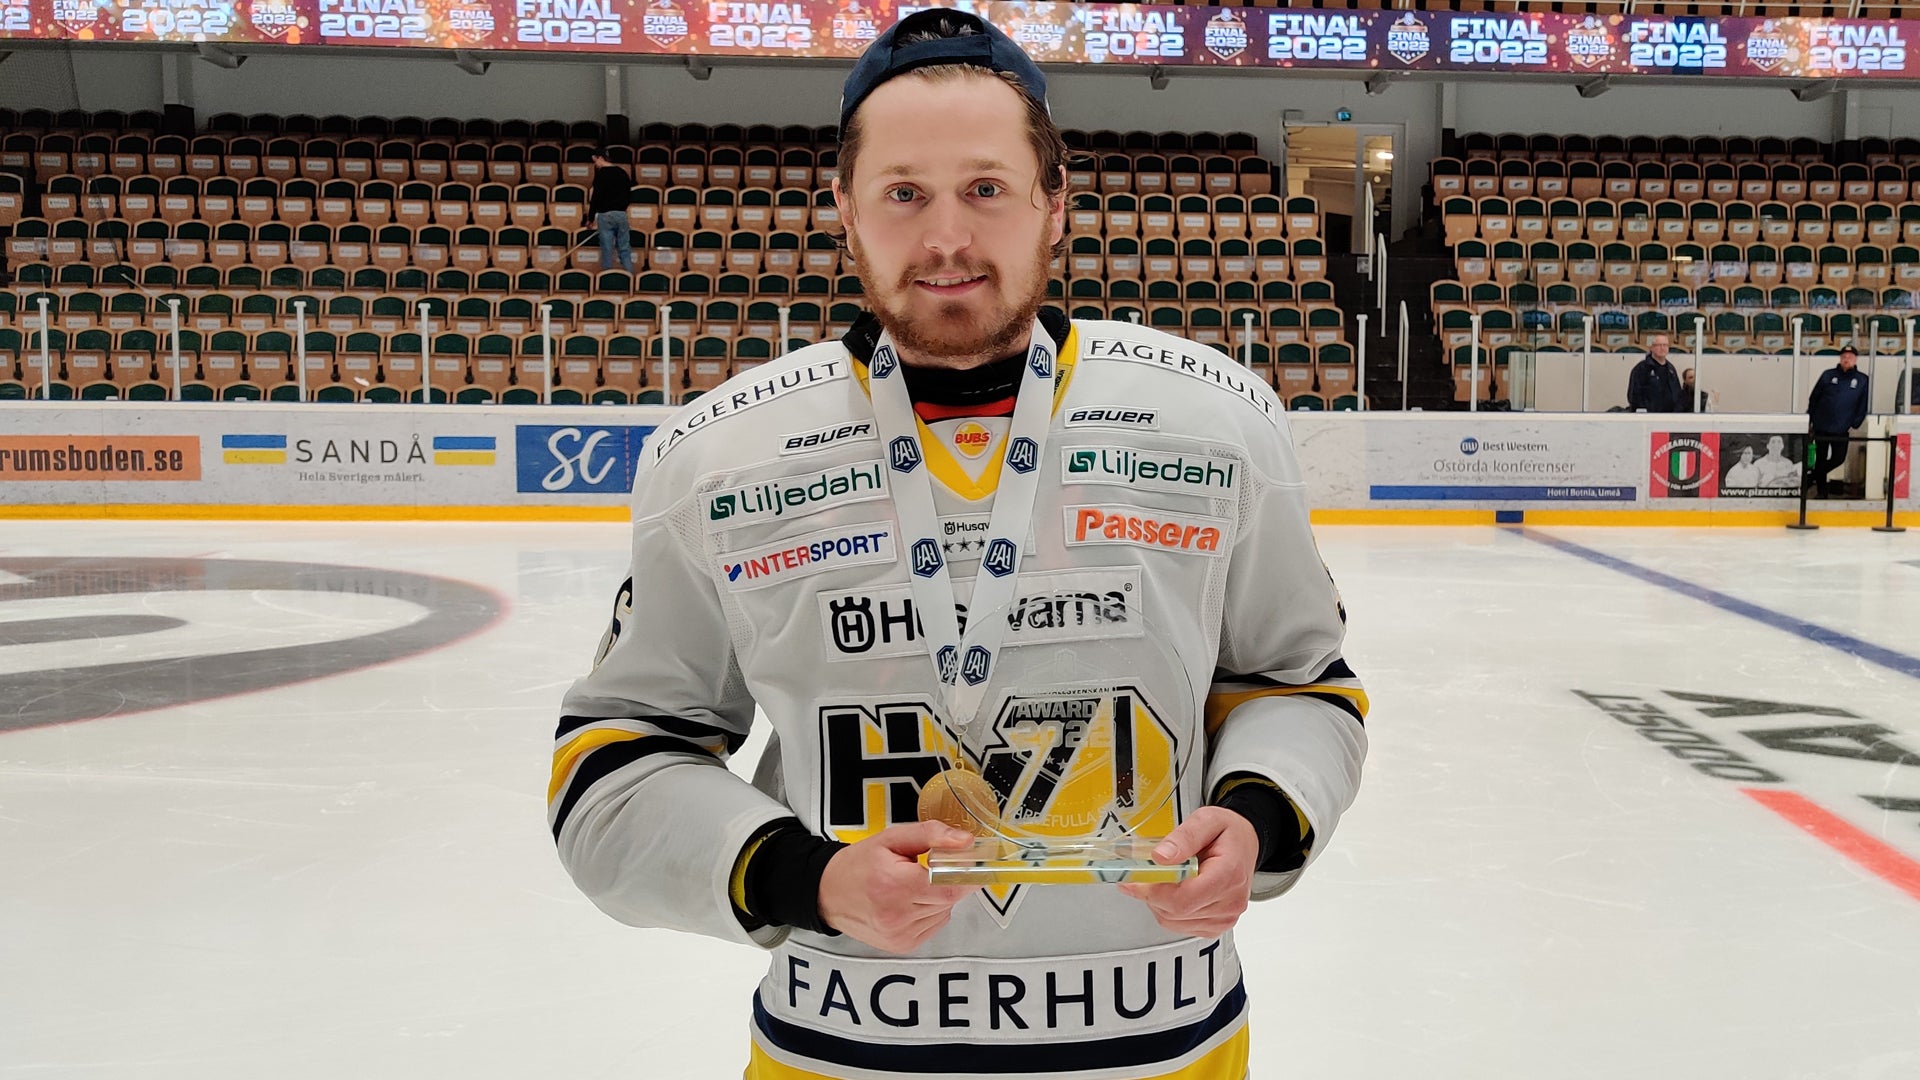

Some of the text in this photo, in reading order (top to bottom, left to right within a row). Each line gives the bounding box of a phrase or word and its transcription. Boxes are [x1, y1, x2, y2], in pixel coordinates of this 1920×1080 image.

[53, 10, 98, 20] 2022
[252, 14, 296, 24] 2022
[450, 10, 494, 20] FINAL
[516, 0, 621, 20] FINAL
[643, 16, 687, 25] FINAL
[708, 3, 811, 24] FINAL
[122, 9, 229, 34] 2022
[320, 14, 426, 38] 2022
[450, 20, 495, 30] 2022
[517, 20, 621, 44] 2022
[643, 25, 688, 35] 2022
[1085, 11, 1185, 33] FINAL
[1268, 14, 1367, 37] FINAL
[1451, 18, 1548, 40] FINAL
[709, 25, 811, 48] 2022
[1205, 28, 1247, 37] FINAL
[1205, 37, 1247, 47] 2022
[1388, 31, 1429, 41] FINAL
[1568, 35, 1609, 45] FINAL
[1631, 22, 1727, 44] FINAL
[1747, 38, 1788, 48] FINAL
[1809, 25, 1905, 46] FINAL
[1085, 33, 1185, 56] 2022
[1268, 37, 1367, 60] 2022
[1388, 41, 1429, 51] 2022
[1450, 40, 1548, 64] 2022
[1568, 44, 1609, 55] 2022
[1630, 43, 1727, 67] 2022
[1747, 47, 1788, 58] 2022
[1809, 46, 1905, 70] 2022
[1089, 339, 1273, 415] FAGERHULT
[655, 361, 840, 458] FAGERHULT
[296, 433, 426, 464] SANDÅ
[955, 432, 990, 444] BUBS
[1483, 442, 1503, 451] Best
[1507, 442, 1548, 451] Western
[0, 445, 183, 471] rumsboden.se
[1493, 458, 1576, 474] konferenser
[299, 472, 425, 484] Hela Sveriges måleri.
[1102, 450, 1234, 488] Liljedahl
[741, 463, 882, 515] Liljedahl
[1547, 488, 1620, 498] Hotel Botnia, Umeå
[956, 521, 990, 531] Husqv
[1075, 508, 1220, 551] Passera
[743, 533, 884, 579] INTERSPORT
[1015, 700, 1102, 719] AWARD
[786, 939, 1221, 1030] FAGERHULT
